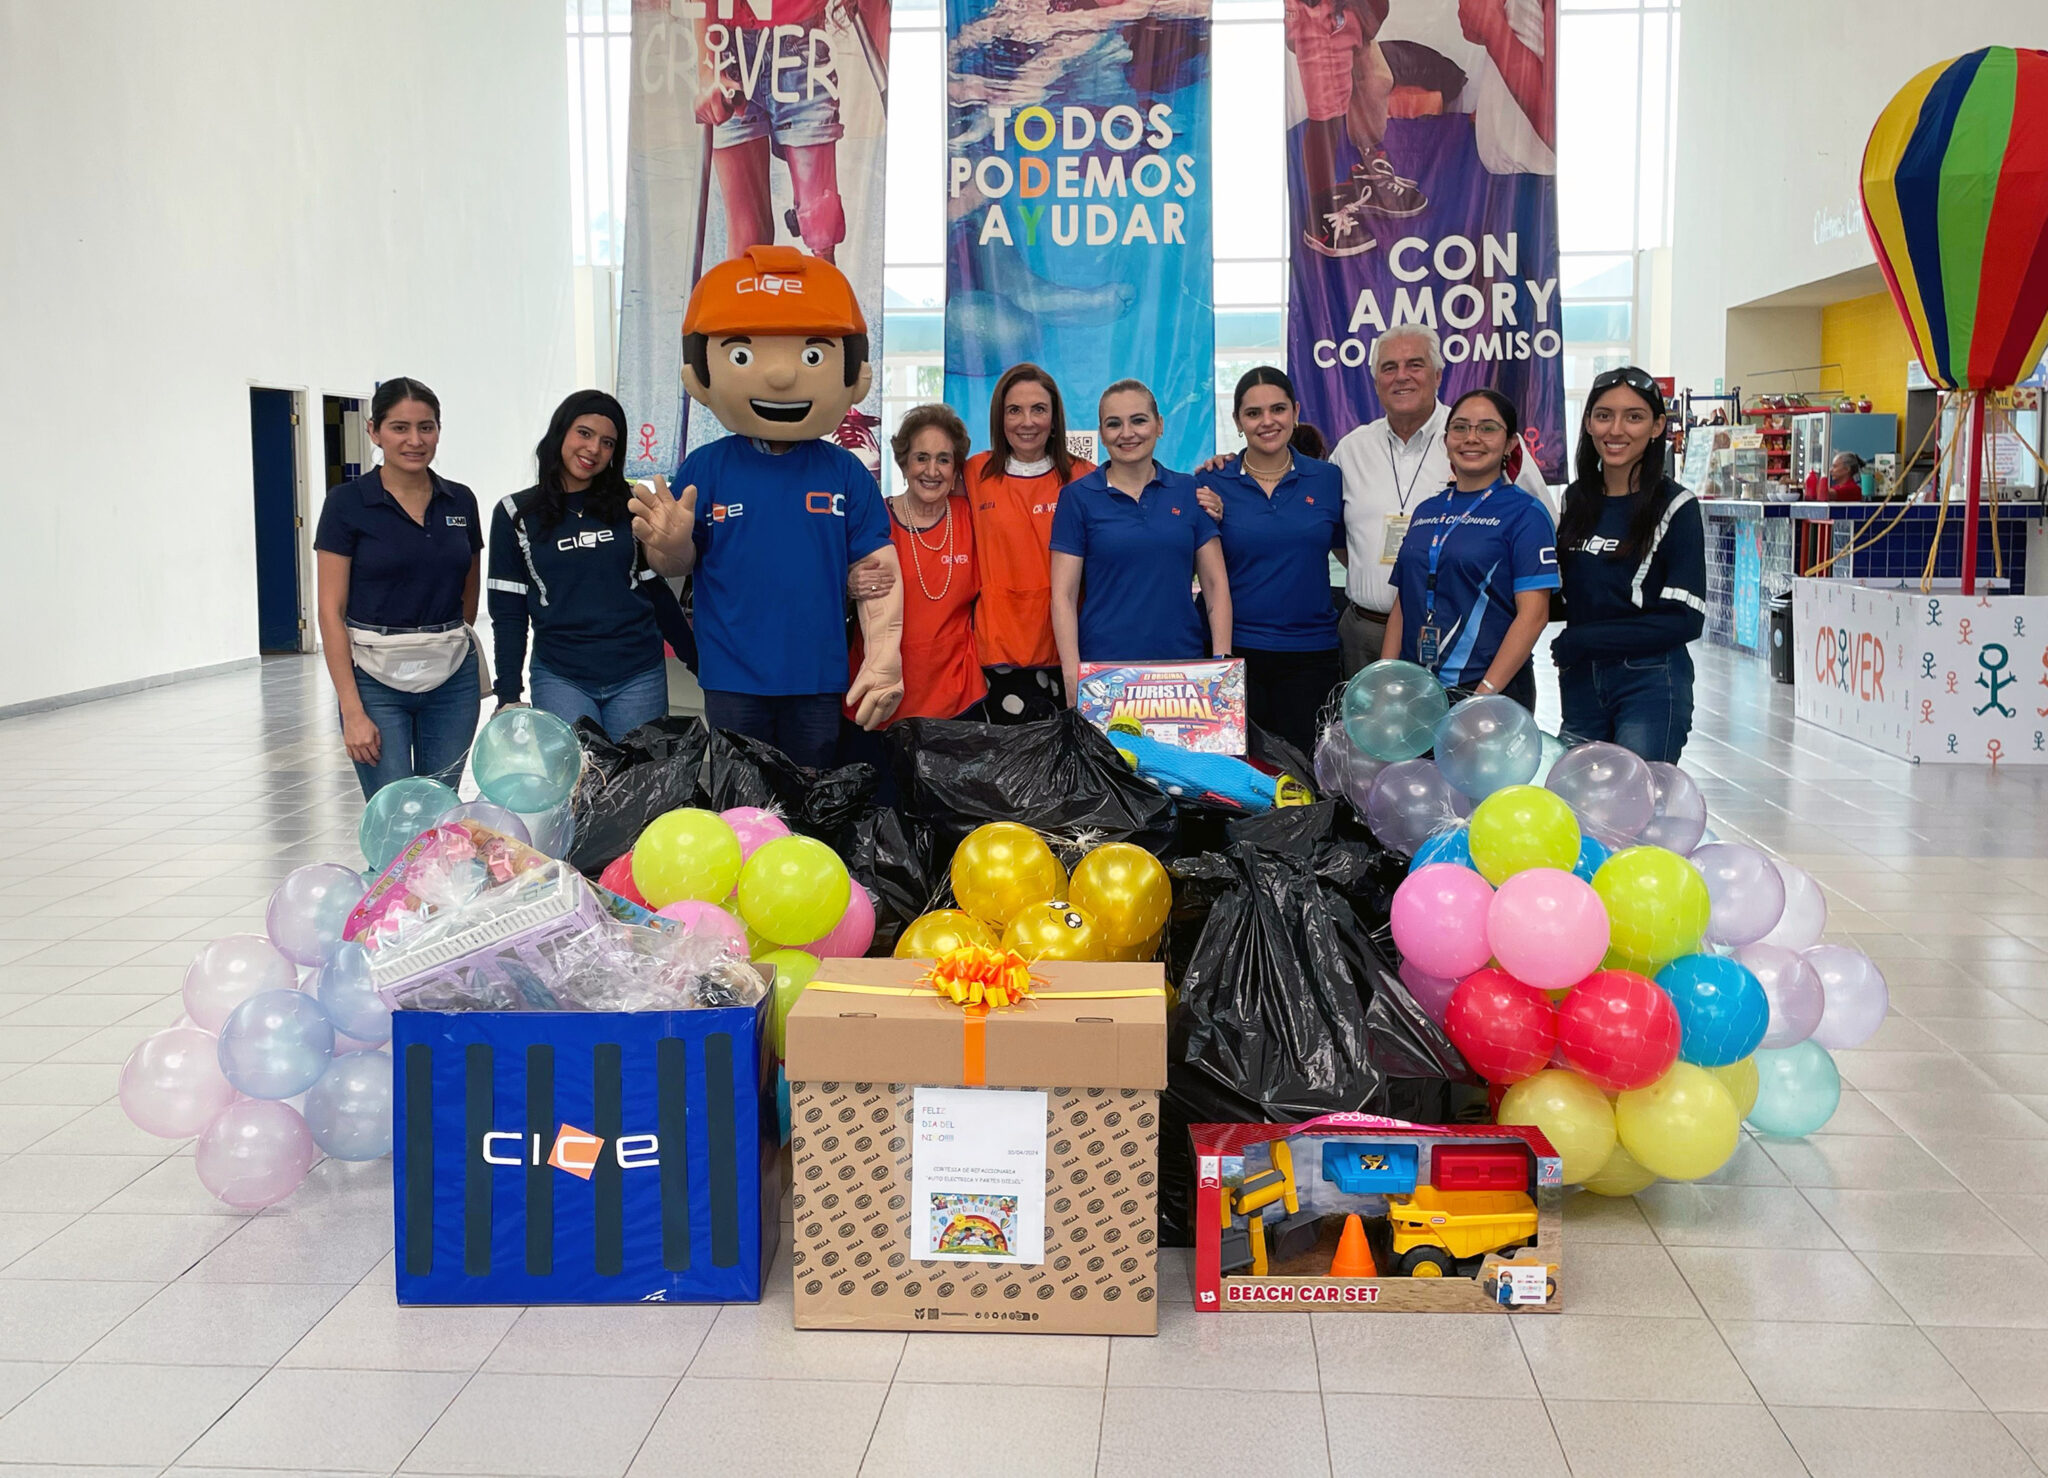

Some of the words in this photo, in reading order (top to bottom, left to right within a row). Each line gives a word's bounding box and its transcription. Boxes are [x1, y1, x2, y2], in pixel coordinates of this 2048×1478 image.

[989, 104, 1173, 151] TODOS
[950, 154, 1196, 198] PODEMOS
[978, 203, 1186, 246] AYUDAR
[1389, 232, 1518, 282] CON
[1348, 283, 1518, 333] AMOR
[1526, 278, 1558, 323] Y
[1313, 329, 1561, 368] COOMISO
[1127, 684, 1198, 699] TURISTA
[1112, 698, 1219, 721] MUNDIAL
[922, 1107, 946, 1115] FELIZ
[922, 1120, 938, 1128] DIA
[940, 1121, 955, 1129] DEL
[1545, 1164, 1555, 1177] 7
[1228, 1286, 1294, 1301] BEACH
[1299, 1287, 1340, 1301] CAR
[1344, 1287, 1379, 1301] SET
